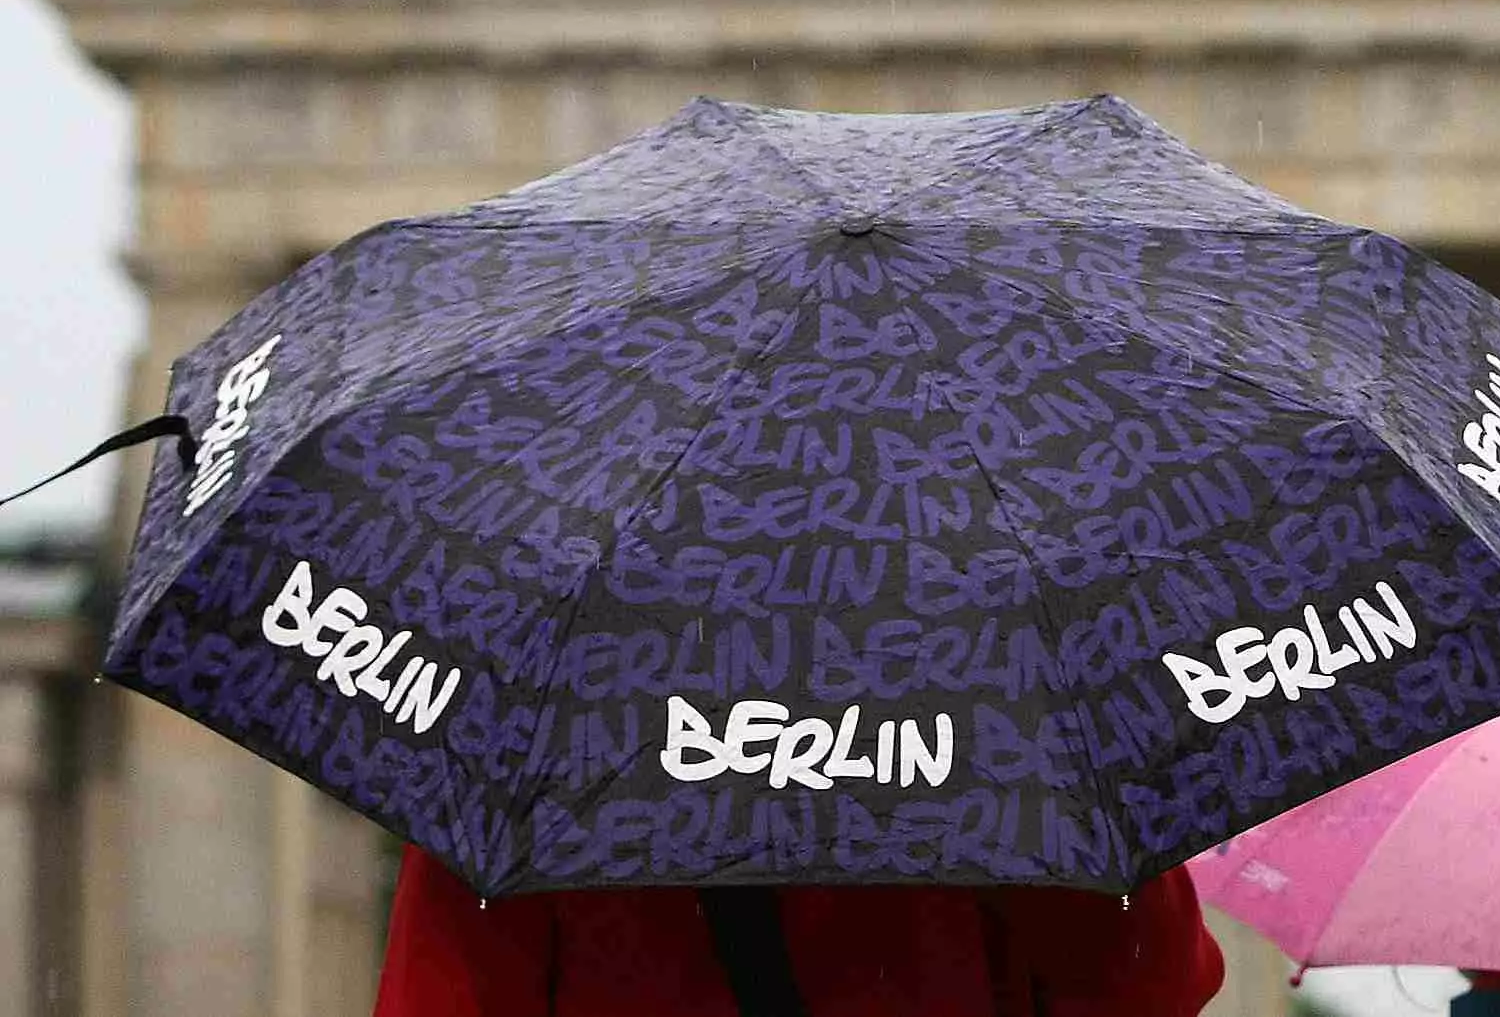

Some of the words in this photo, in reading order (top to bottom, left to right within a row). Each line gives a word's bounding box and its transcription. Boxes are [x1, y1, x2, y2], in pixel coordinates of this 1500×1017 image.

[262, 560, 461, 734] BERLIN
[1162, 581, 1417, 724] BERLIN
[660, 695, 955, 791] BERLIN
